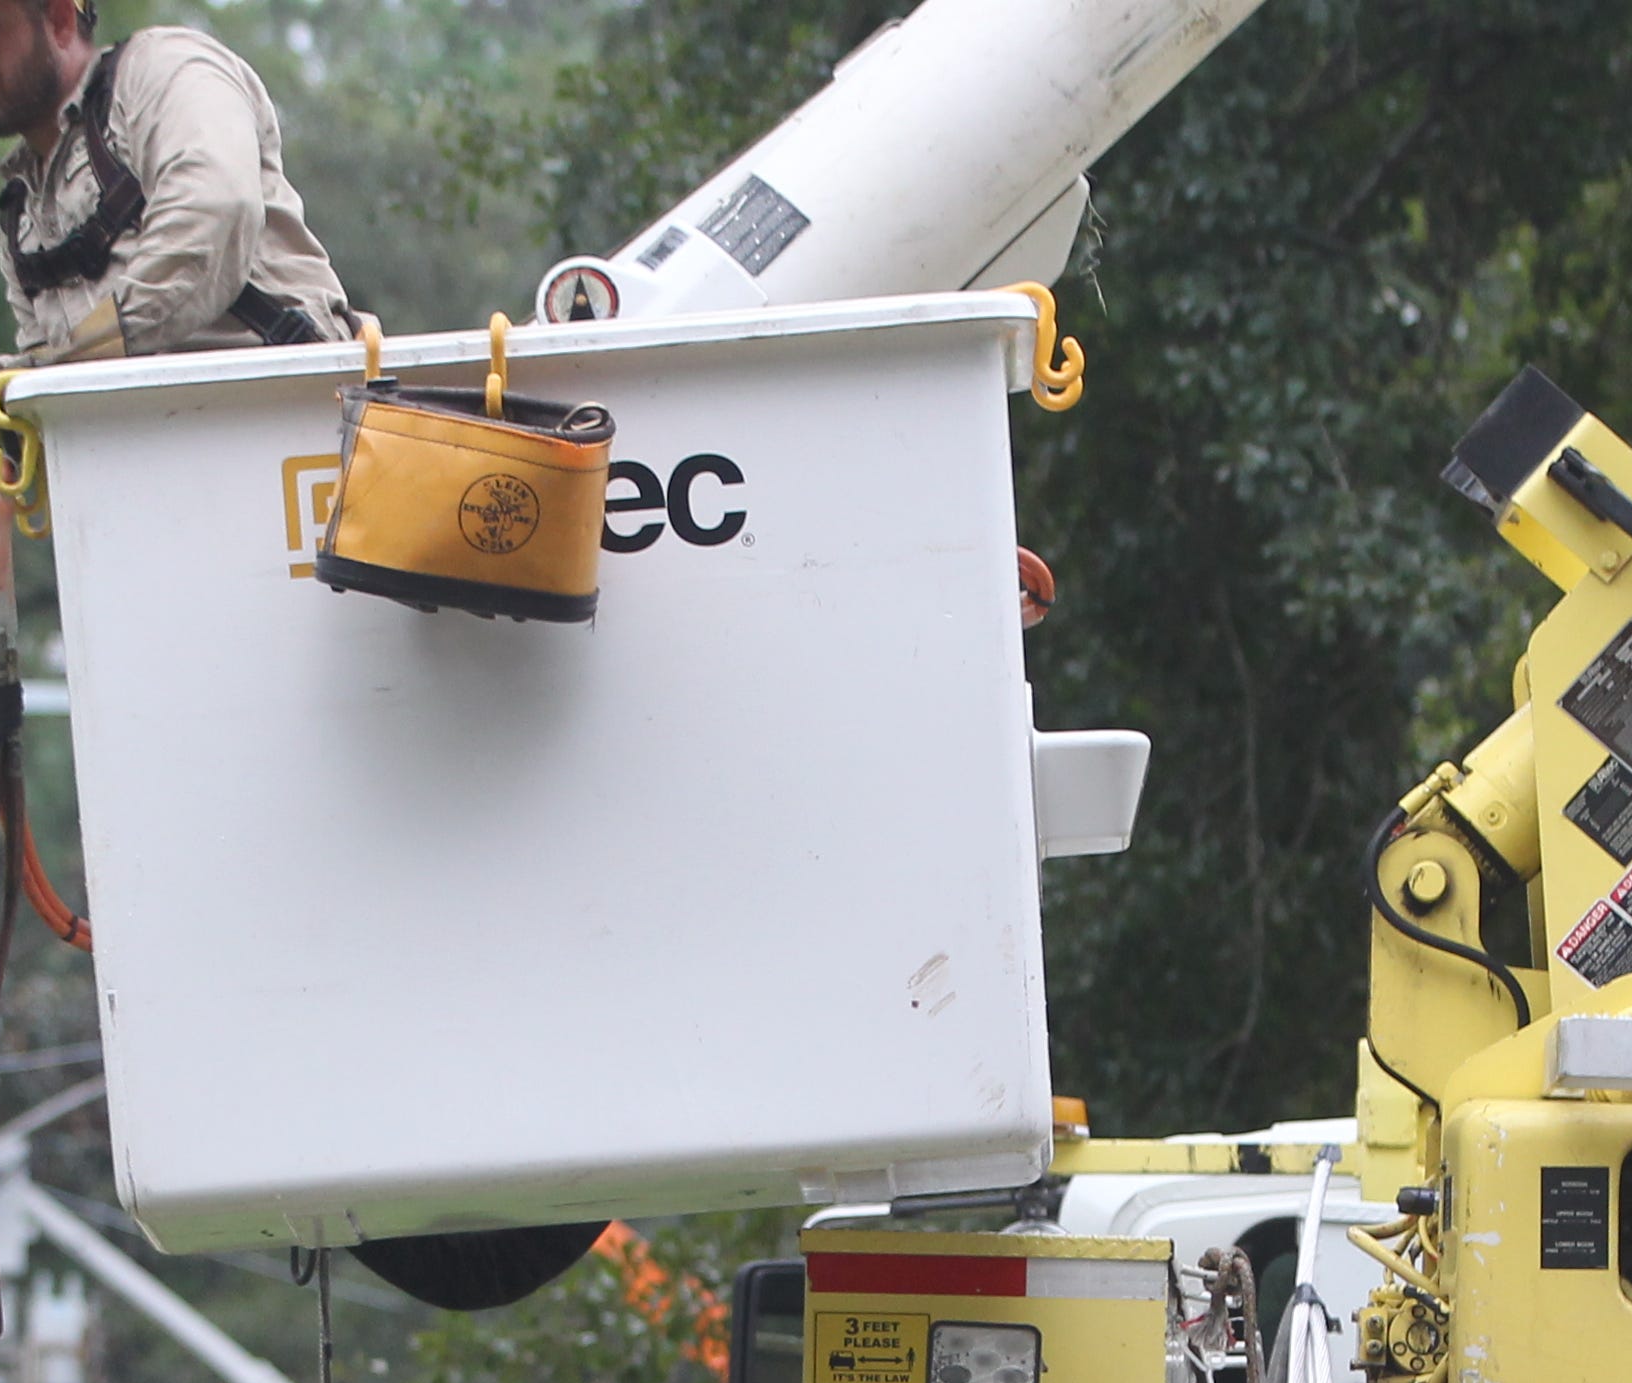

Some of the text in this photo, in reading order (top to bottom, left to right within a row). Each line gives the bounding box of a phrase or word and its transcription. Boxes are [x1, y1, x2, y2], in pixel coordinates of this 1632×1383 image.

[1567, 902, 1608, 948] DANGER
[845, 1318, 900, 1335] 3 FEET
[844, 1337, 901, 1348] PLEASE
[833, 1373, 910, 1383] IT'S THE LAW
